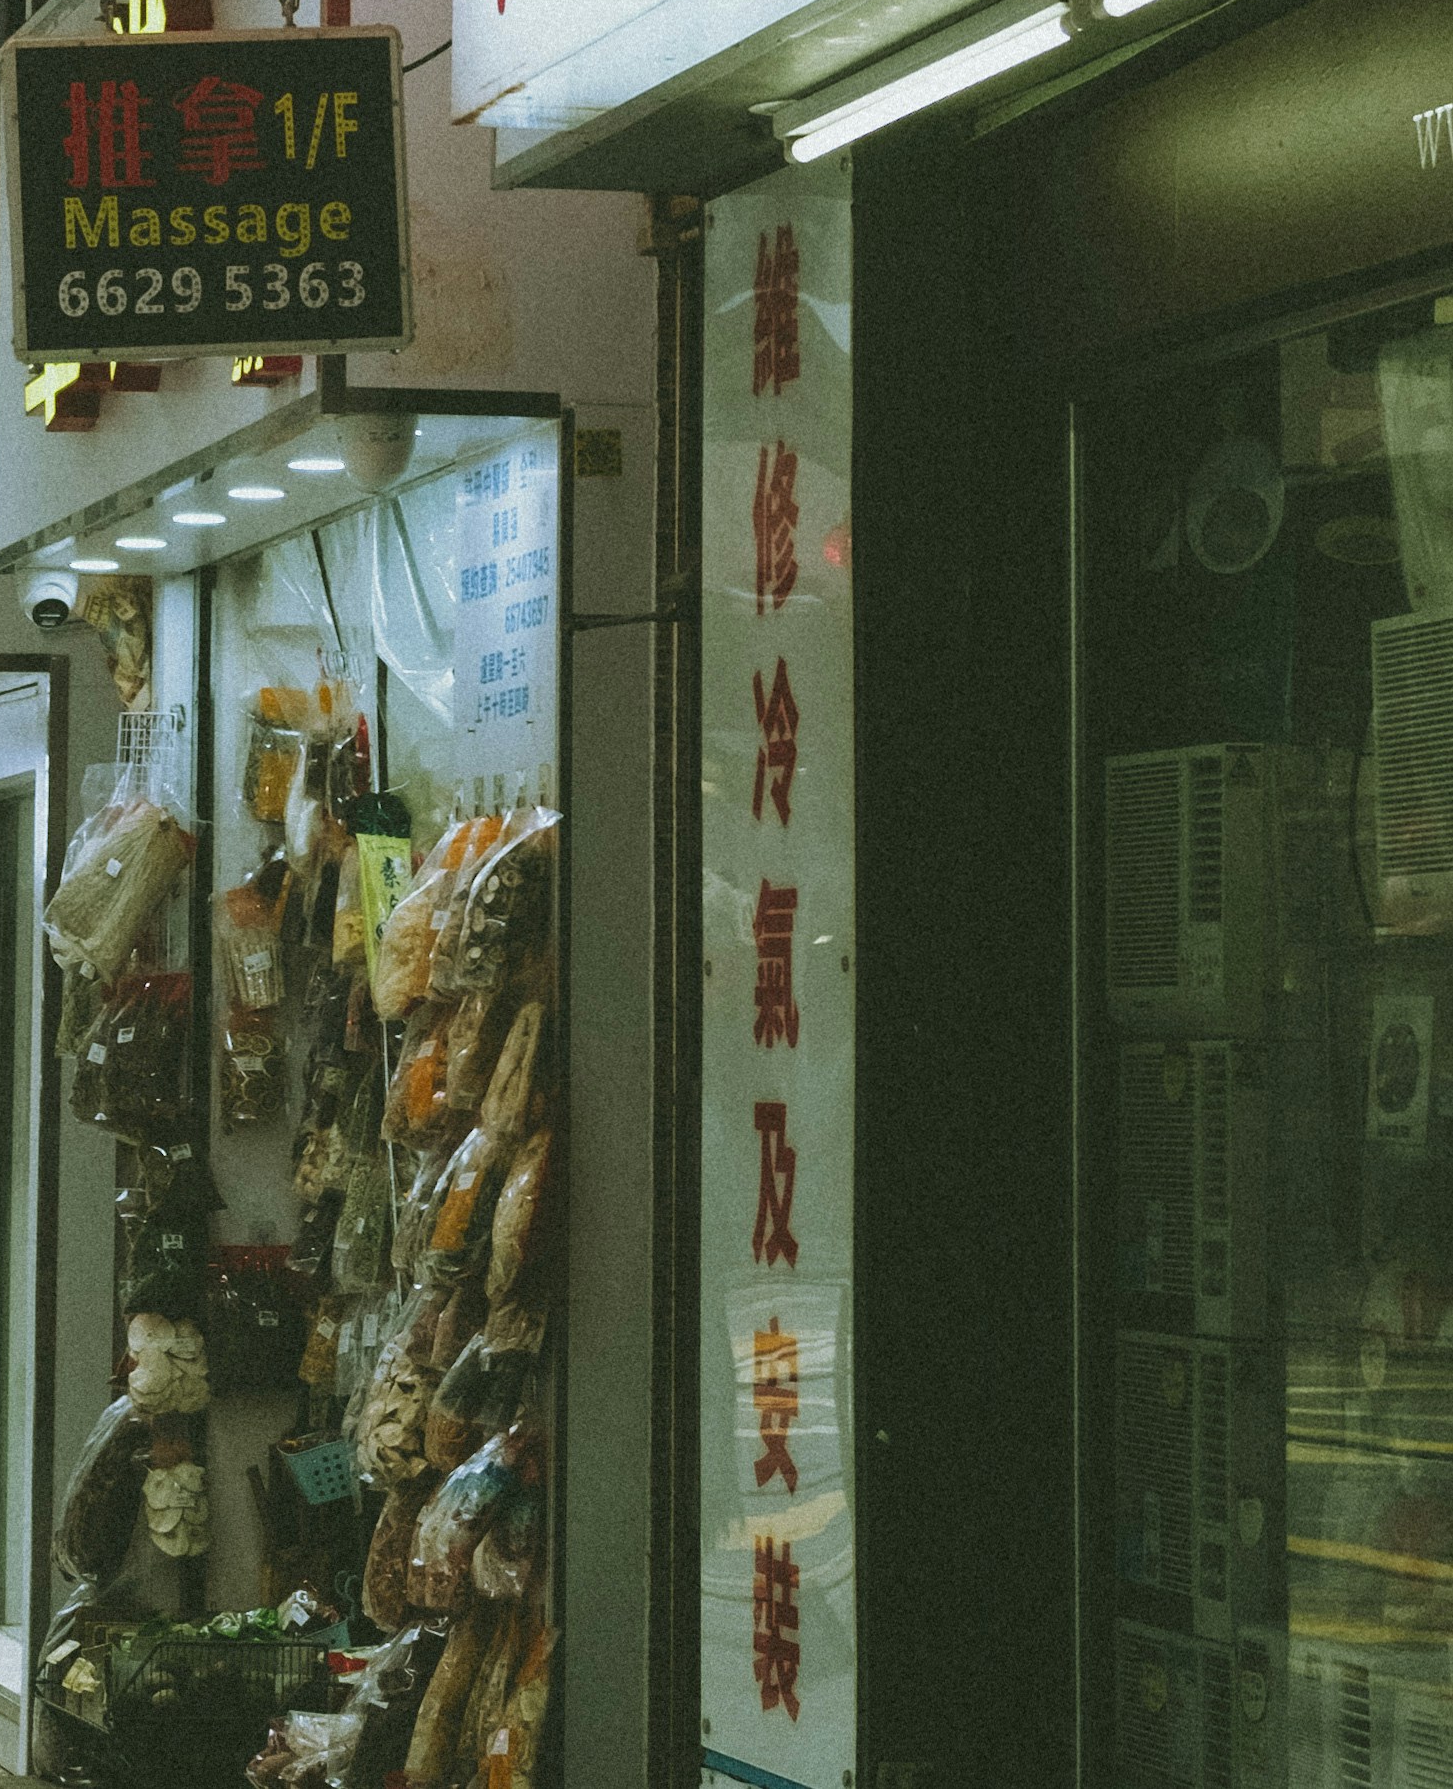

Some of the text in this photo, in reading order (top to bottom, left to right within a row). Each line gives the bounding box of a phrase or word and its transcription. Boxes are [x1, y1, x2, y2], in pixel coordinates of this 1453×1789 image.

[61, 76, 359, 188] 推拿 1/F
[63, 195, 353, 258] Massage
[58, 261, 366, 318] 6629 5363
[752, 221, 799, 1724] 維修冷氣及安裝
